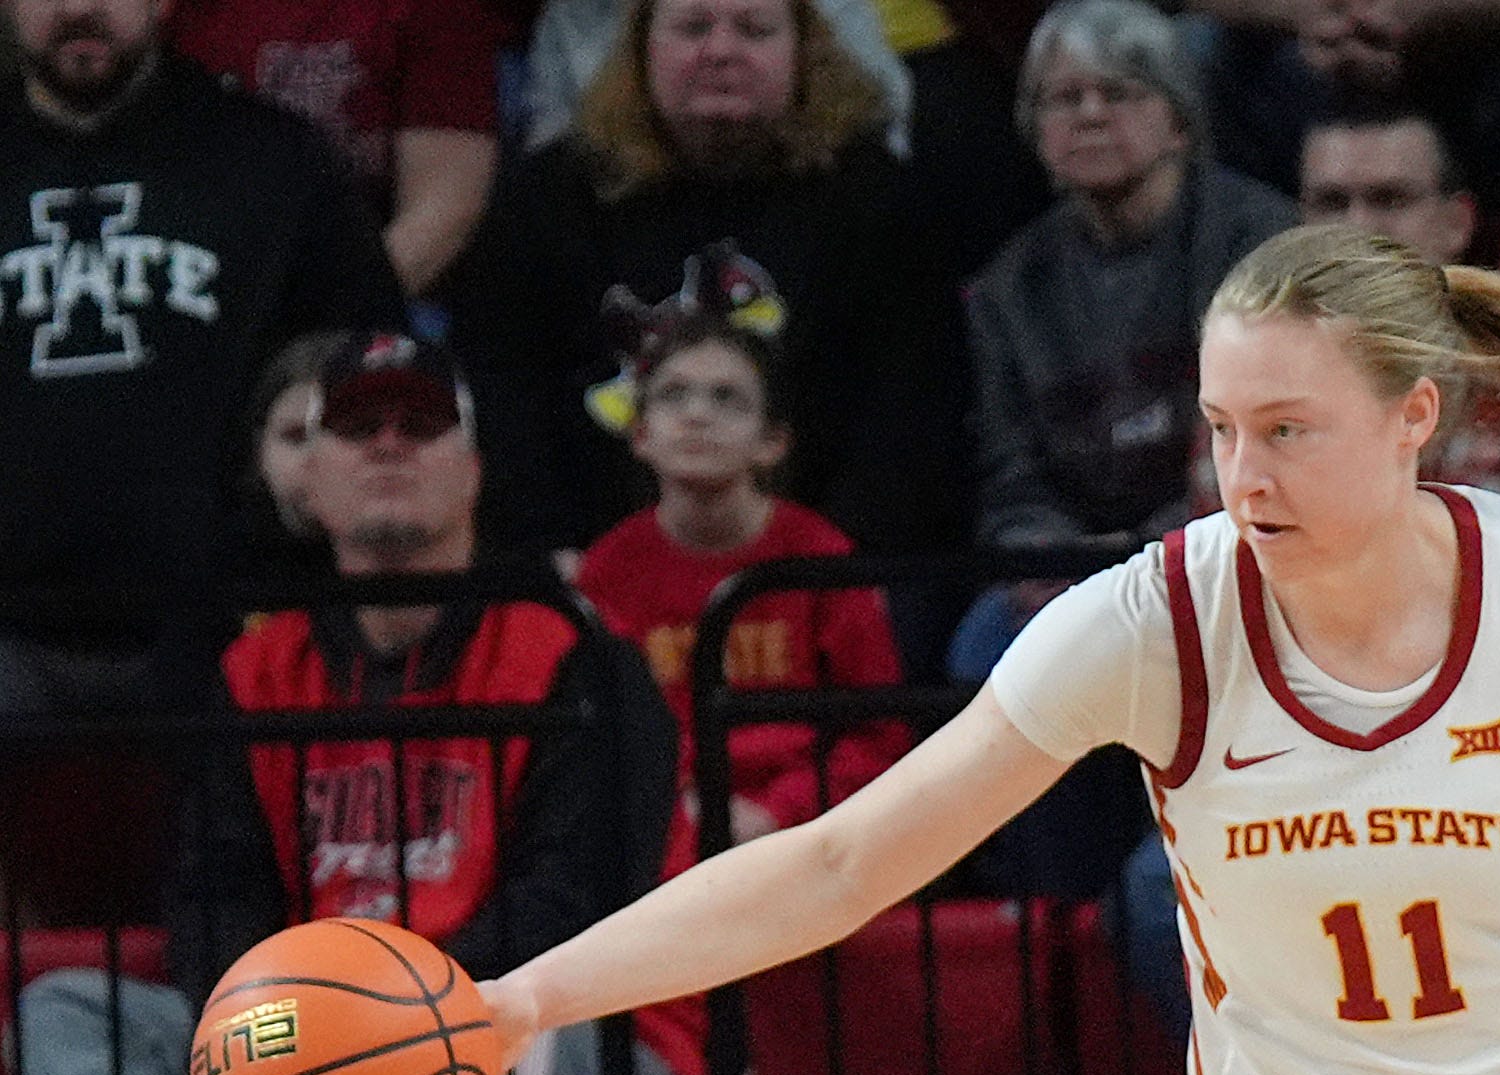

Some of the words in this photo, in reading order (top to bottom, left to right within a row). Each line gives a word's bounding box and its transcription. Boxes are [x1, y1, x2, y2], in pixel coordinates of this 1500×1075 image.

[0, 234, 219, 322] TATE
[1225, 809, 1357, 861] IOWA
[1320, 898, 1467, 1021] 11
